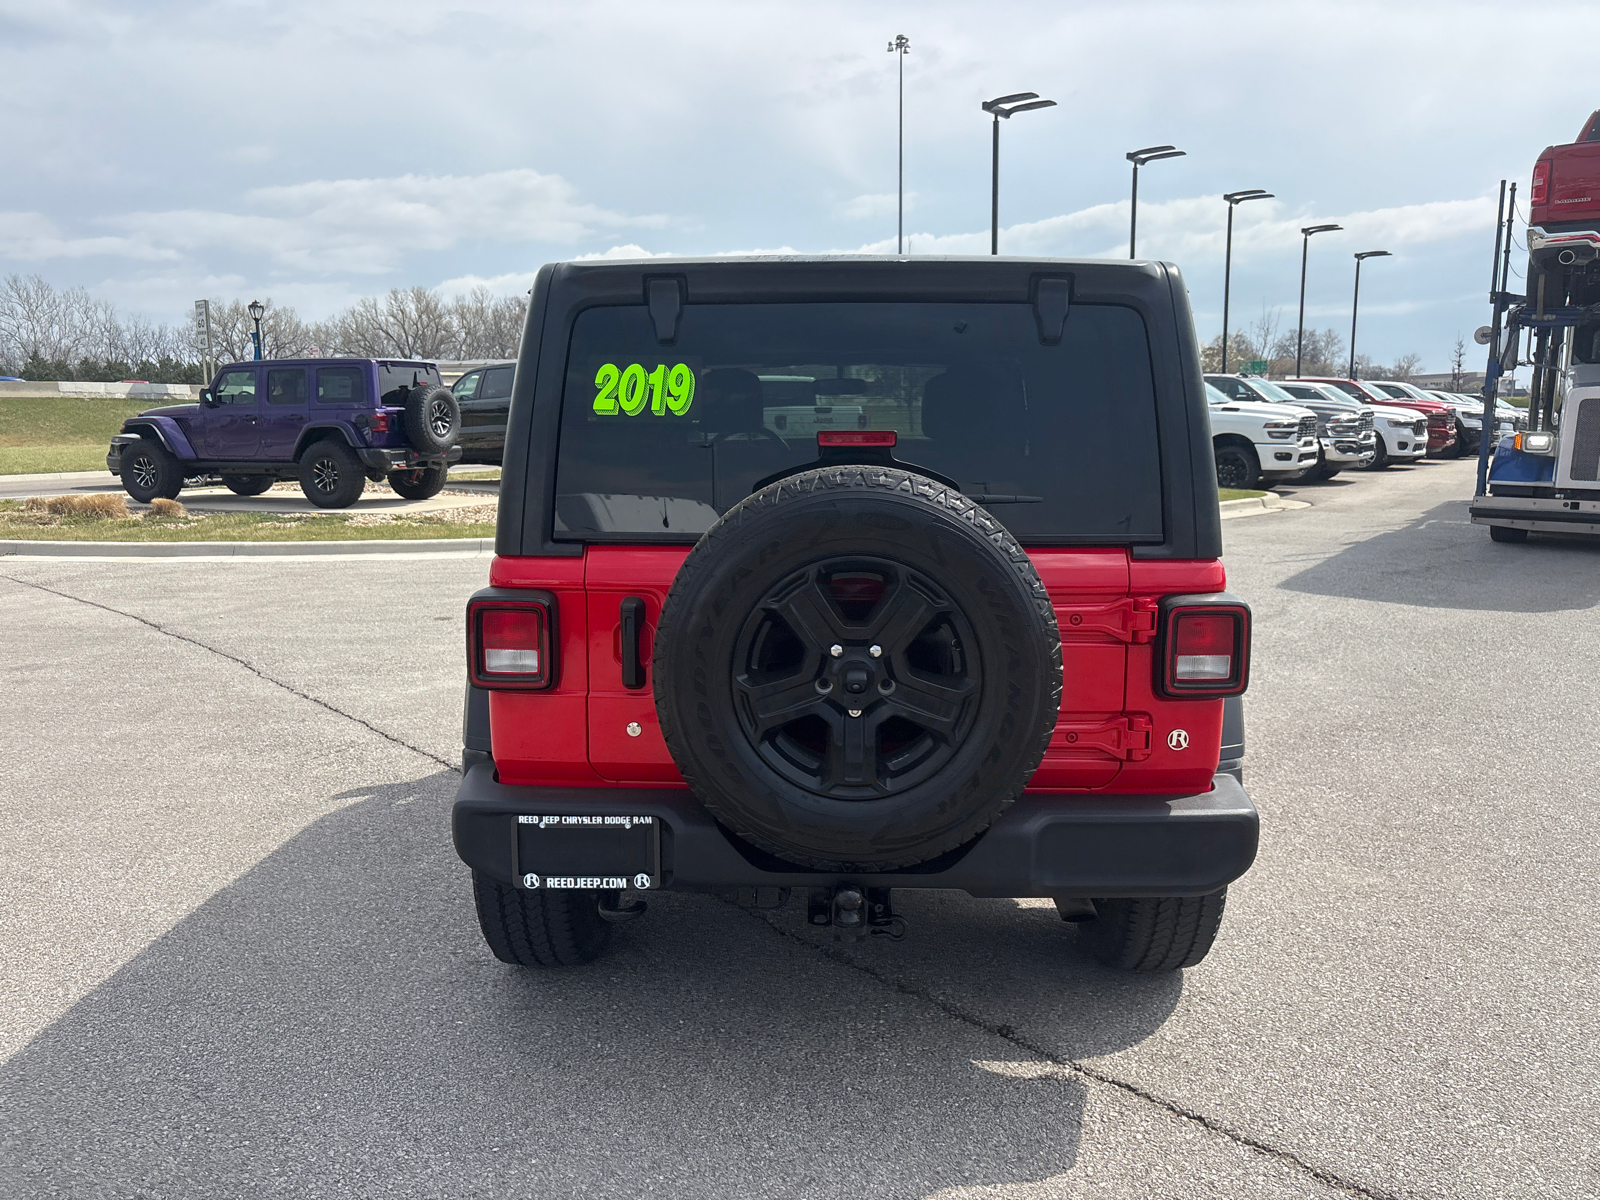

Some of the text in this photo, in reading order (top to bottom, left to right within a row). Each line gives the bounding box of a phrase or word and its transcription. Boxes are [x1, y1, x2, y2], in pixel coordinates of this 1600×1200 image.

[198, 318, 204, 328] 60
[200, 338, 206, 346] 40
[592, 363, 695, 416] 2019
[813, 416, 834, 424] Jeep
[541, 816, 560, 824] JEEP
[562, 816, 602, 824] CHRYSLER
[546, 878, 627, 888] REEDJEEP.COM
